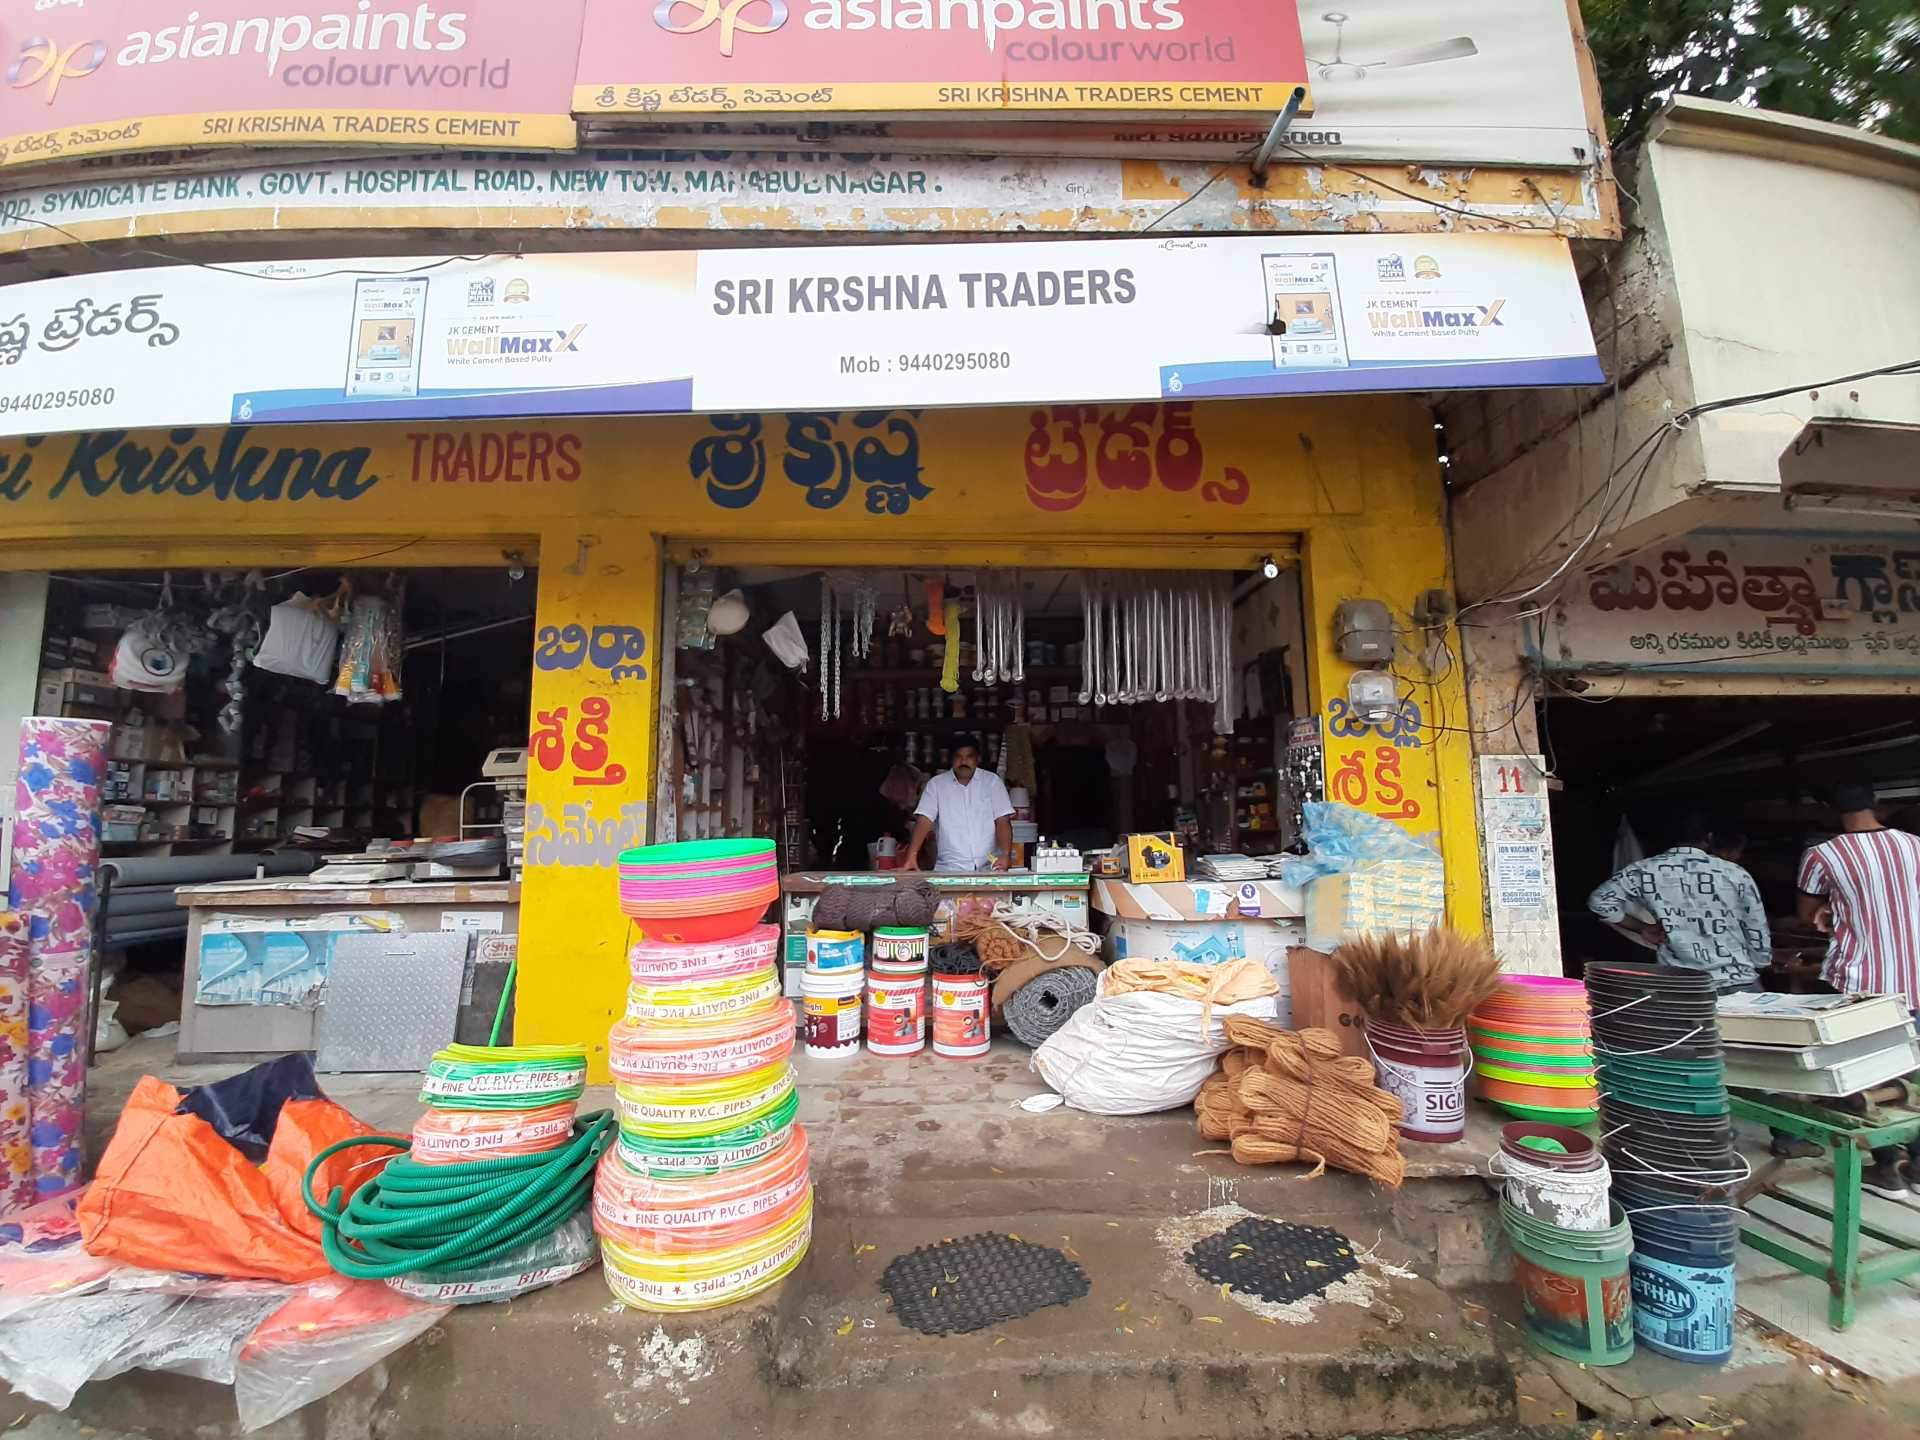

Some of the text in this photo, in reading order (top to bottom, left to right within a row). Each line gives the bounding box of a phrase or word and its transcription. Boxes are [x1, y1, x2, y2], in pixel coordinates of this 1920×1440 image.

[938, 87, 1263, 103] SRI KRISHNA TRADERS CEMENT
[202, 115, 521, 137] SRI KRISHNA TRADERS CEMENT
[41, 179, 168, 214] SYNDICATE
[259, 171, 338, 196] GOVT.
[344, 168, 467, 194] HOSPITAL
[474, 169, 544, 193] ROAD,
[551, 168, 609, 193] NEW
[713, 268, 1137, 317] SRI KRSHNA TRADERS
[1366, 299, 1418, 309] JK CEMENT
[38, 293, 181, 352] ట్రేడర్స్
[448, 325, 500, 336] JK CEMENT
[1372, 328, 1480, 337] White Cement Based Putty
[448, 354, 552, 366] White Cement Based Putty
[839, 354, 881, 374] Mob
[898, 351, 1011, 373] 9440295080
[48, 424, 379, 502] Krishna
[406, 431, 583, 484] TRADERS
[534, 623, 648, 681] బిర్లా
[528, 696, 627, 786] శక్తి
[1332, 746, 1421, 819] శక్తి
[1497, 766, 1525, 793] 11
[734, 946, 758, 958] PIPES
[681, 956, 708, 969] FINE
[740, 989, 760, 1004] FINE
[635, 1005, 656, 1016] PIPES
[688, 998, 737, 1016] QUALITY
[731, 1036, 773, 1056] QUALITY
[640, 1059, 689, 1072] QUALITY
[529, 1072, 560, 1082] PIPES
[441, 1082, 464, 1094] FINE
[622, 1099, 752, 1119] FINE QUALITY P.V.C. PIPES
[533, 1121, 558, 1137] PIPES
[474, 1134, 504, 1147] FINE
[723, 1141, 768, 1163] QUALITY
[657, 1156, 687, 1167] PIPES
[635, 1212, 660, 1225] FINE
[663, 1209, 716, 1225] QUALITY
[720, 1203, 750, 1218] P.V.C.
[753, 1194, 779, 1212] PIPES
[761, 1241, 797, 1272] QUALITY
[730, 1264, 759, 1284] P.V.C.
[437, 1283, 478, 1298] BPL
[638, 1280, 663, 1296] FINE
[693, 1276, 726, 1295] PIPES
